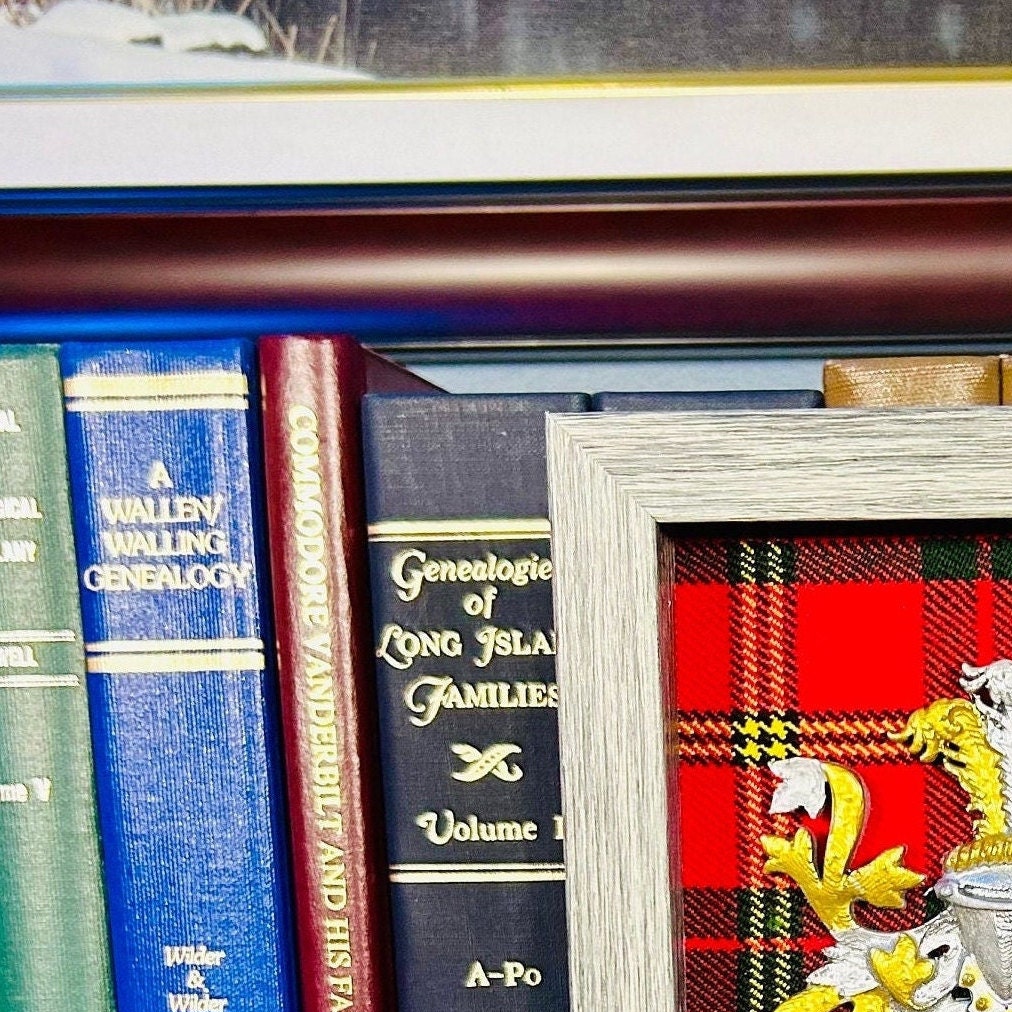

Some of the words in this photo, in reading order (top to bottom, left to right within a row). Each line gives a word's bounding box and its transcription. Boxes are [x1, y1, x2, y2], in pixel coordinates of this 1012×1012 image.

[150, 459, 174, 489] A
[288, 405, 330, 627] COMMODORE
[101, 529, 229, 556] WALLING
[83, 562, 252, 592] GENEALOGY
[390, 548, 553, 603] Genealogie
[463, 584, 499, 620] of
[376, 622, 463, 671] LONG
[473, 625, 557, 668] ISLA
[403, 674, 559, 728] FAMILIES
[303, 632, 344, 835] VANDERBILT
[415, 807, 539, 847] Volume
[317, 839, 349, 911] AND
[163, 944, 227, 968] Wilder
[325, 917, 353, 969] HIS
[186, 968, 209, 993] &
[464, 959, 543, 988] A-Po
